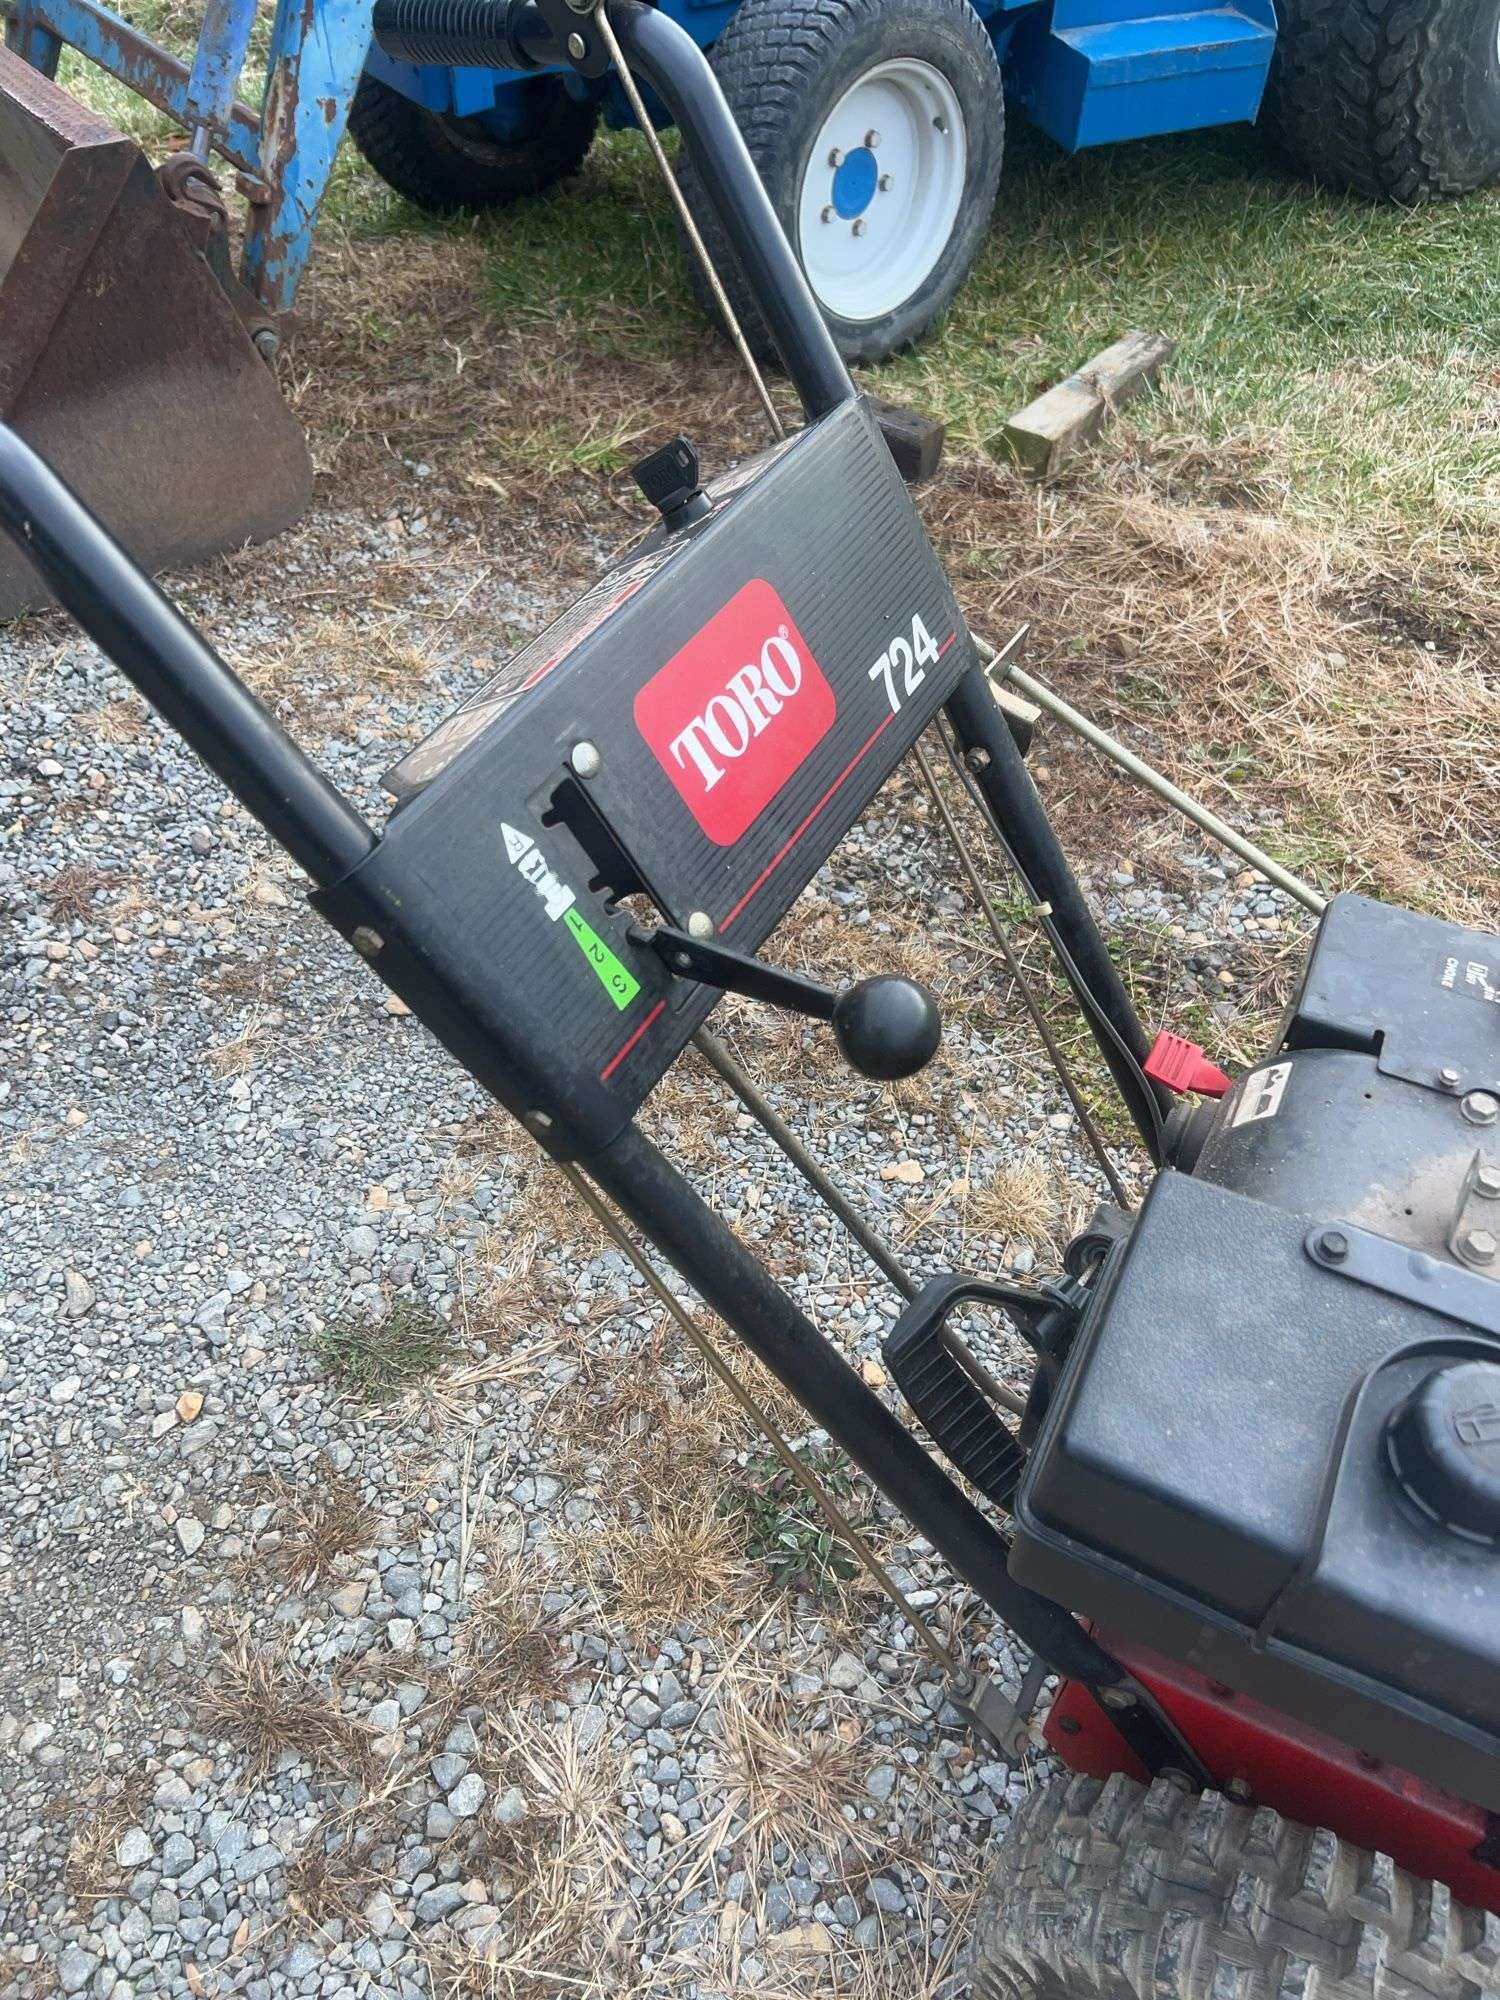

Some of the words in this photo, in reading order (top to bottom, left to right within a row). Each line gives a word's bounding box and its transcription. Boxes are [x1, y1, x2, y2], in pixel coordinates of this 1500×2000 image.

[868, 612, 940, 714] 724
[670, 634, 802, 792] TORO
[589, 943, 605, 963] 2
[612, 975, 627, 993] 3
[1441, 957, 1459, 988] CHOKE
